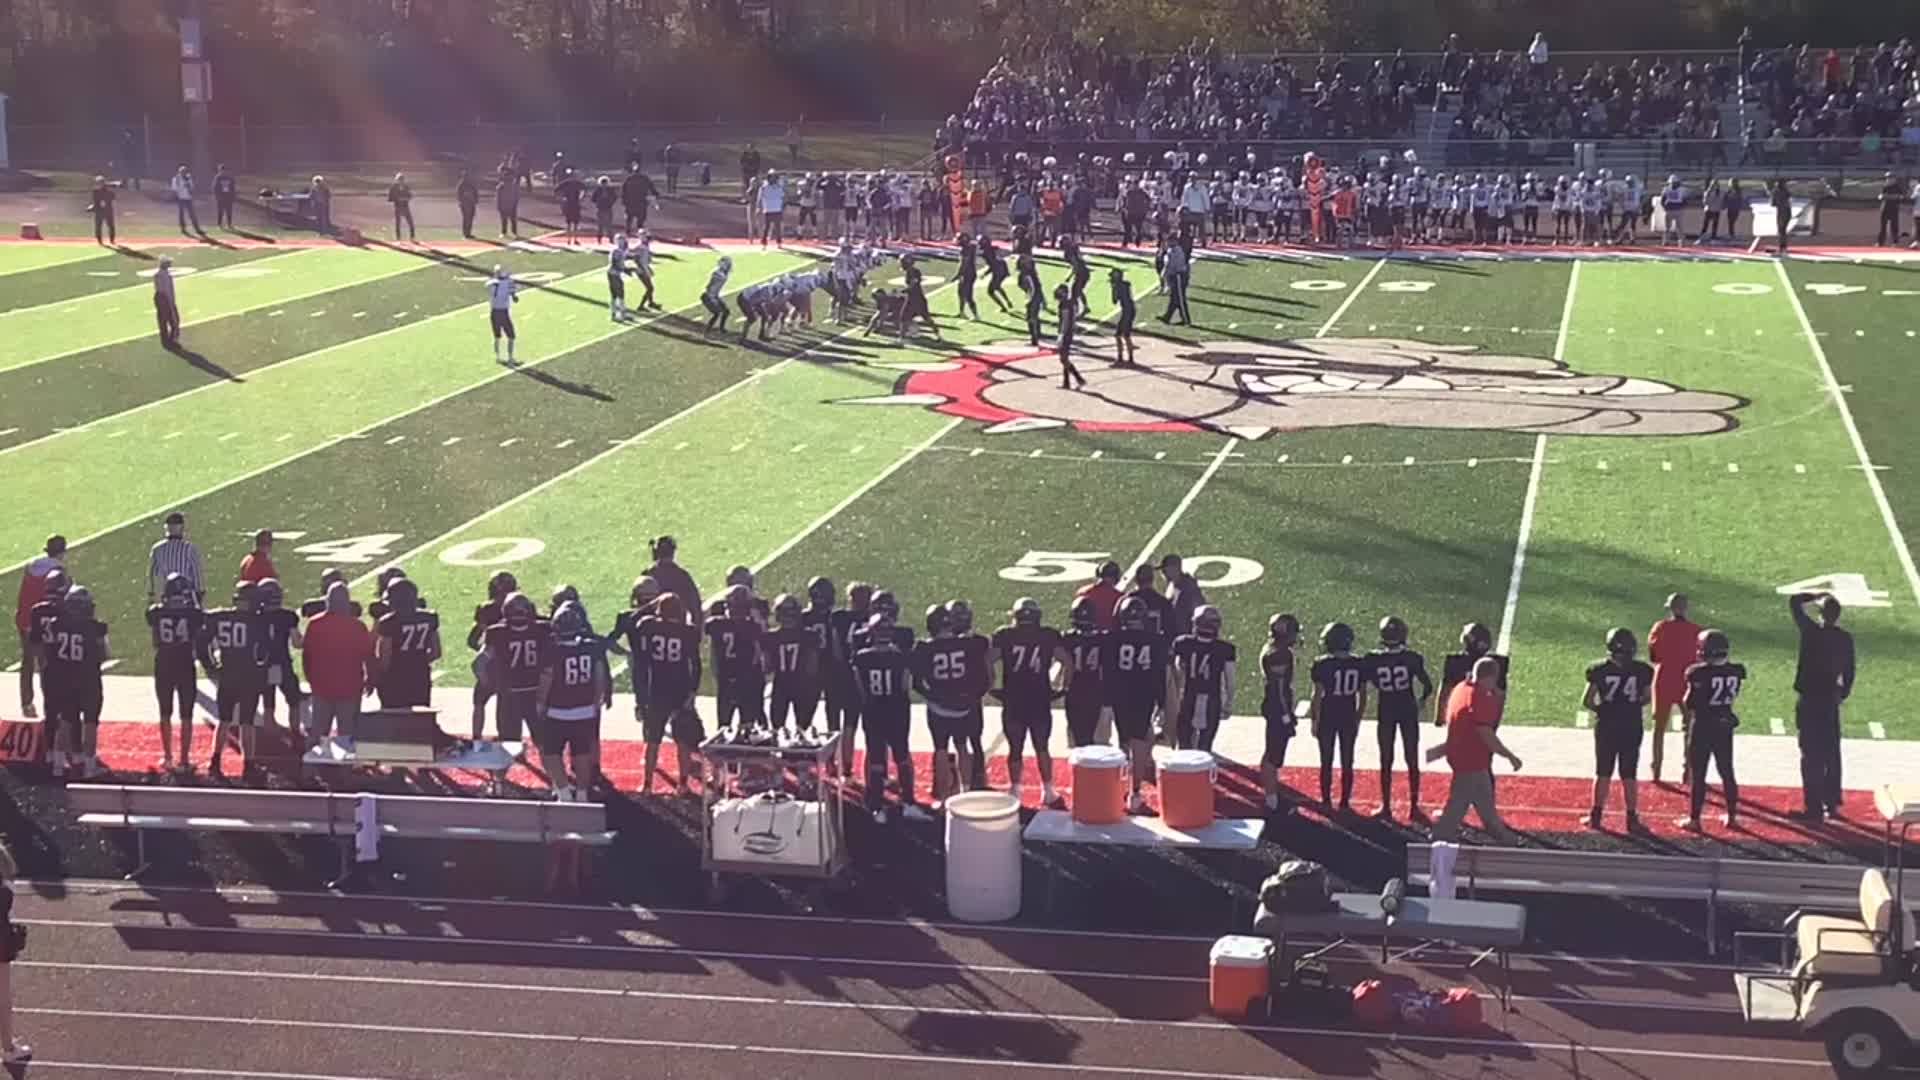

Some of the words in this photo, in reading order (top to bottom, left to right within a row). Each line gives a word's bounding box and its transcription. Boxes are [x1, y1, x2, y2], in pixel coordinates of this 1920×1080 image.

[293, 534, 545, 566] 40
[998, 550, 1264, 587] 50
[159, 618, 189, 642] 64
[218, 621, 246, 647] 50
[401, 623, 430, 650] 77
[57, 632, 84, 661] 26
[509, 640, 536, 668] 76
[652, 635, 681, 661] 38
[779, 643, 799, 671] 17
[1012, 645, 1041, 672] 74
[1119, 645, 1150, 670] 84
[565, 655, 591, 685] 69
[934, 651, 965, 679] 25
[1190, 652, 1210, 680] 14
[1377, 666, 1408, 691] 22
[870, 669, 892, 695] 81
[1333, 669, 1358, 695] 10
[1605, 676, 1638, 703] 74
[1709, 677, 1738, 705] 23
[2, 722, 33, 757] 40
